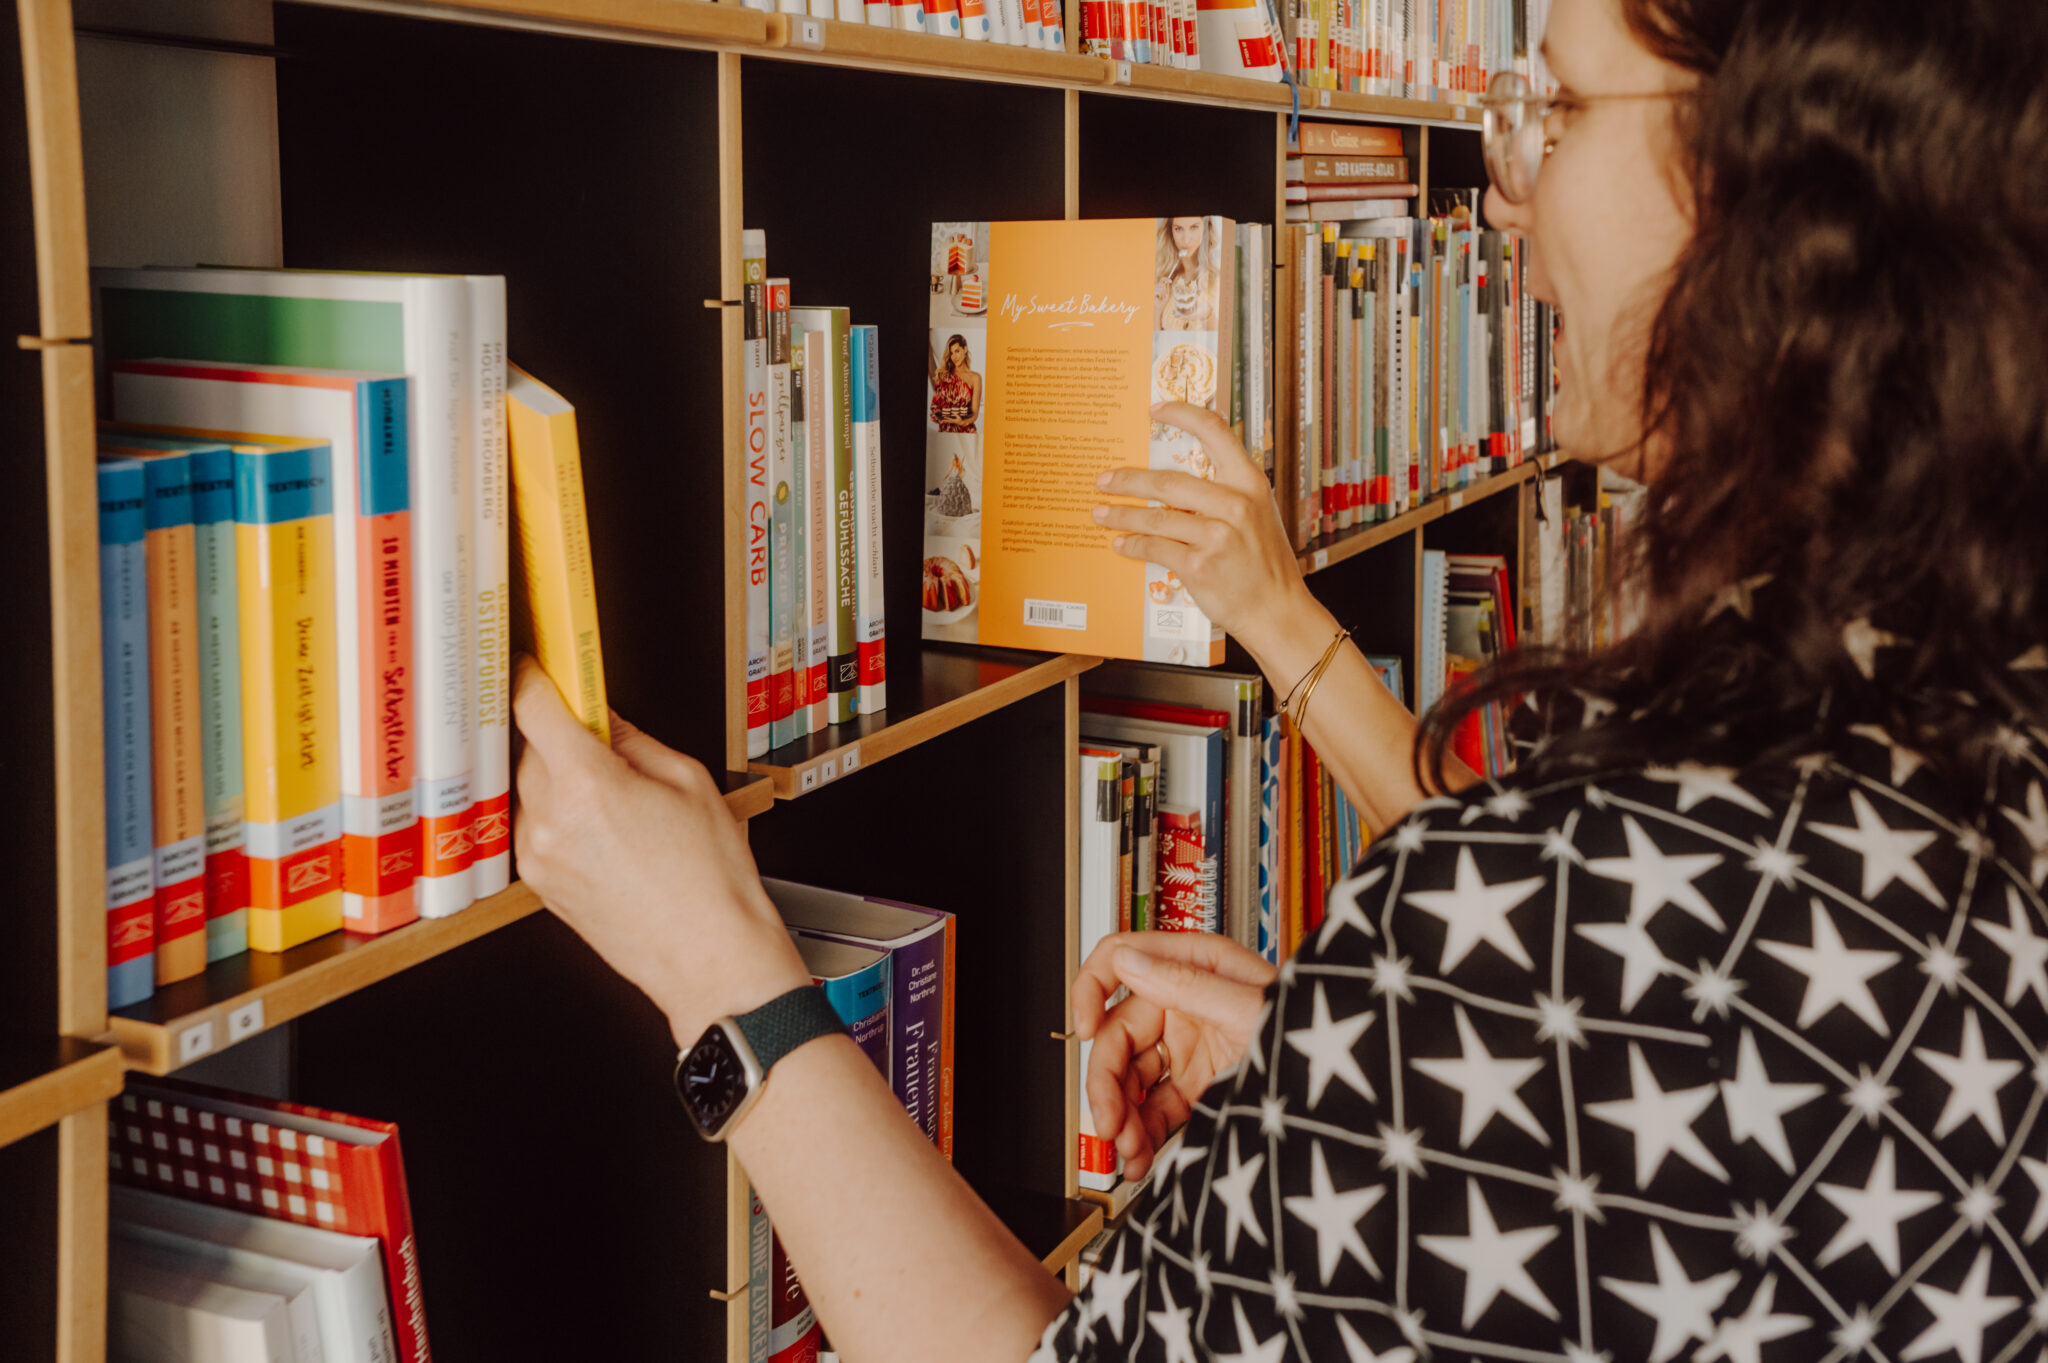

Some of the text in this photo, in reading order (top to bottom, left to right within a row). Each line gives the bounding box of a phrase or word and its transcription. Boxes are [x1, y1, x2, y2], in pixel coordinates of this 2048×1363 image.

[1000, 293, 1142, 324] My Sweet Bakery
[842, 334, 851, 449] Prof. Albrecht Hempel
[481, 343, 494, 520] HOLGER STROMBERG
[748, 391, 766, 586] SLOW CARB
[815, 480, 823, 543] RICHTIG
[869, 446, 880, 579] Selbstliebe macht schlank
[382, 537, 400, 554] 10
[778, 522, 788, 642] PRINZIP PU
[816, 550, 824, 579] GUT
[839, 489, 851, 608] GEFÜHLSSACHE
[383, 560, 401, 626] MINUTEN
[478, 589, 497, 729] OSTEOPOROSE
[498, 583, 509, 727] GEMEINSAM GEGEN
[908, 972, 937, 991] Christiane
[910, 985, 937, 1004] Northrup
[911, 959, 935, 977] Dr. med.
[752, 1217, 768, 1279] OHNE
[752, 1280, 768, 1363] ZUCKER
